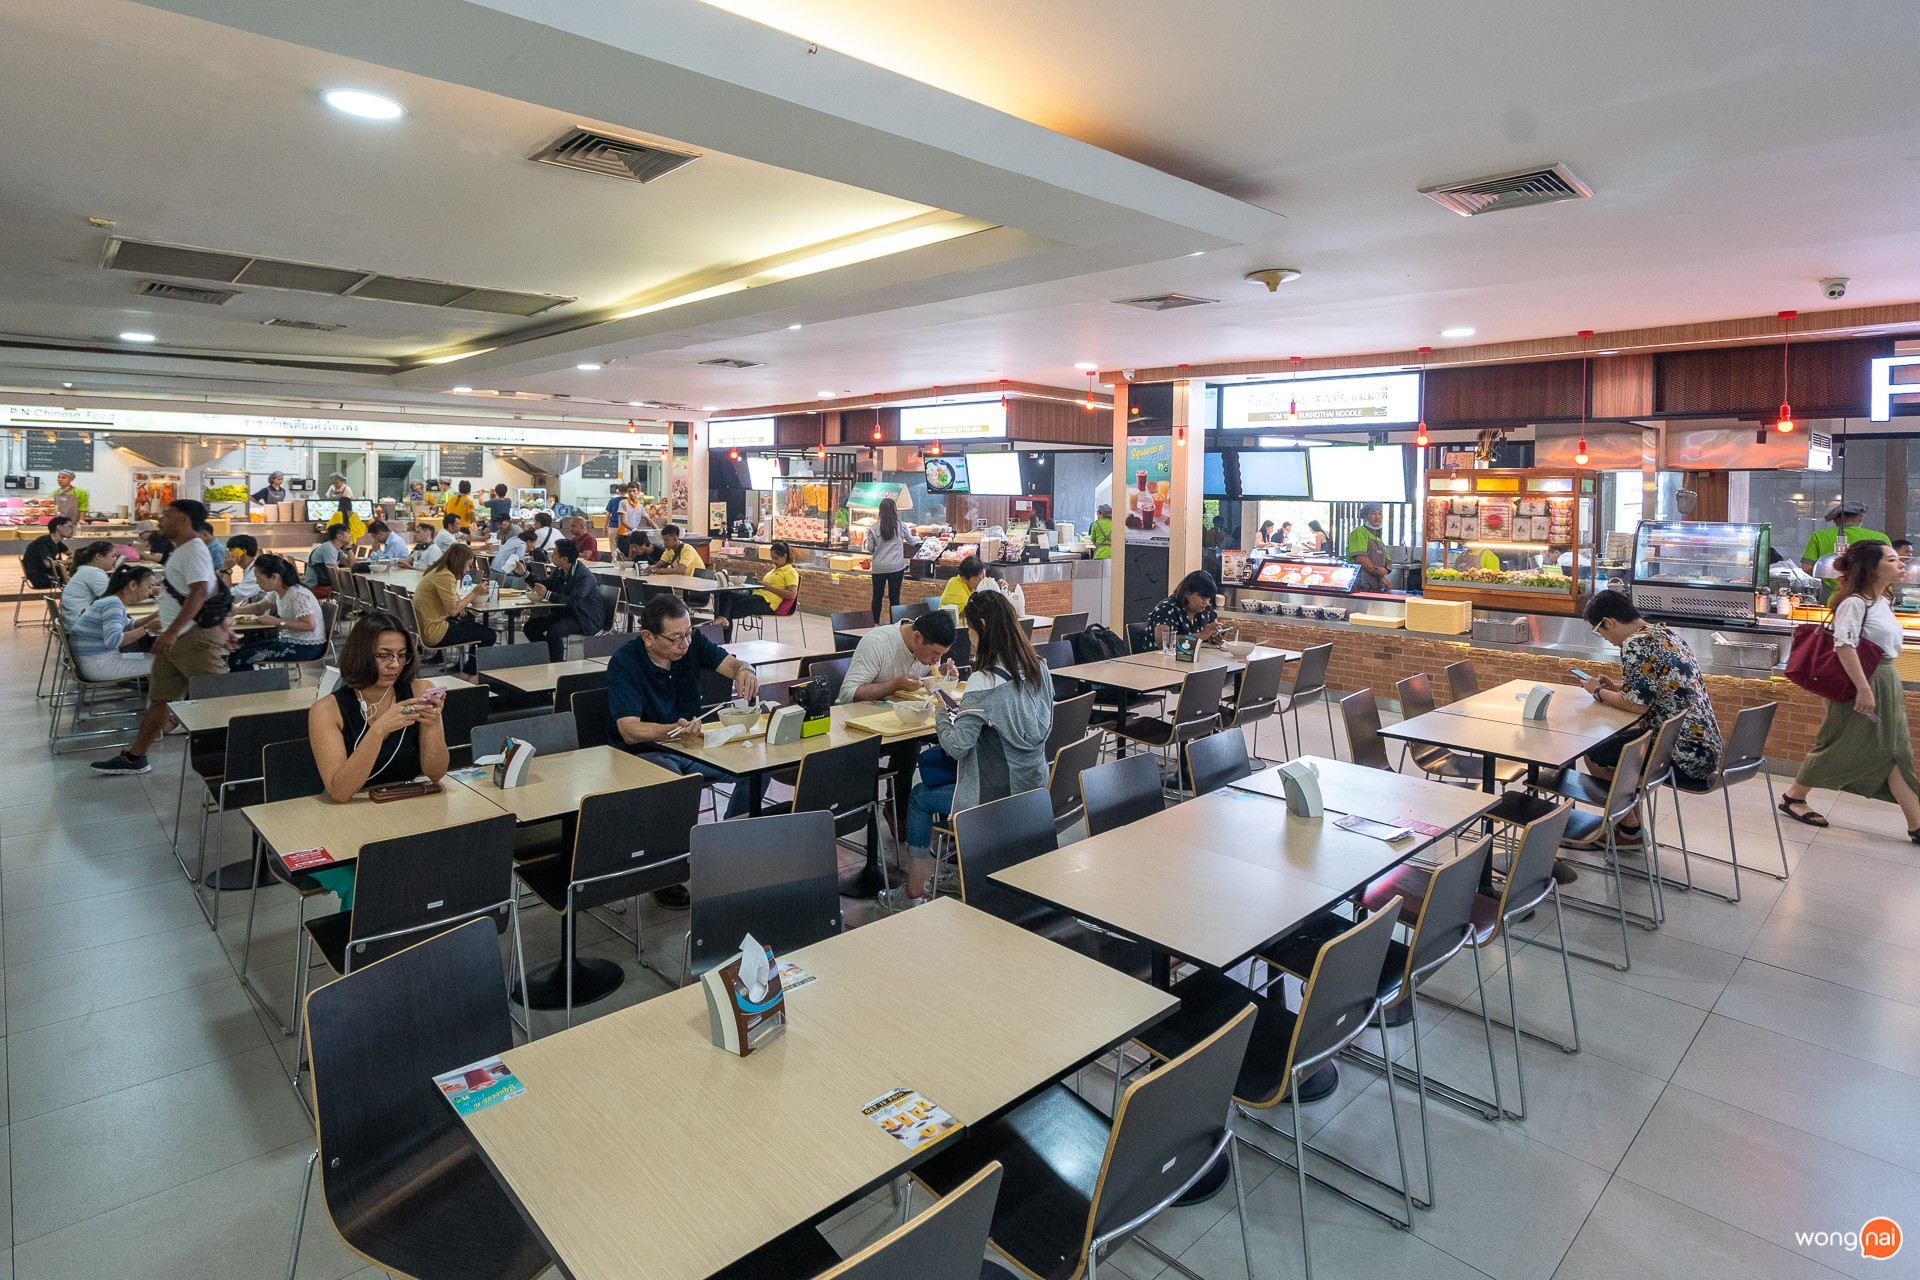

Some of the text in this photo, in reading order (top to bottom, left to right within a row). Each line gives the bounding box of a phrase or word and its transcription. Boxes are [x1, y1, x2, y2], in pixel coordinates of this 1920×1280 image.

[34, 408, 81, 419] Chinese
[86, 411, 115, 420] Food
[1298, 411, 1334, 419] SUKHOTHAI
[1335, 409, 1364, 418] NOODLE
